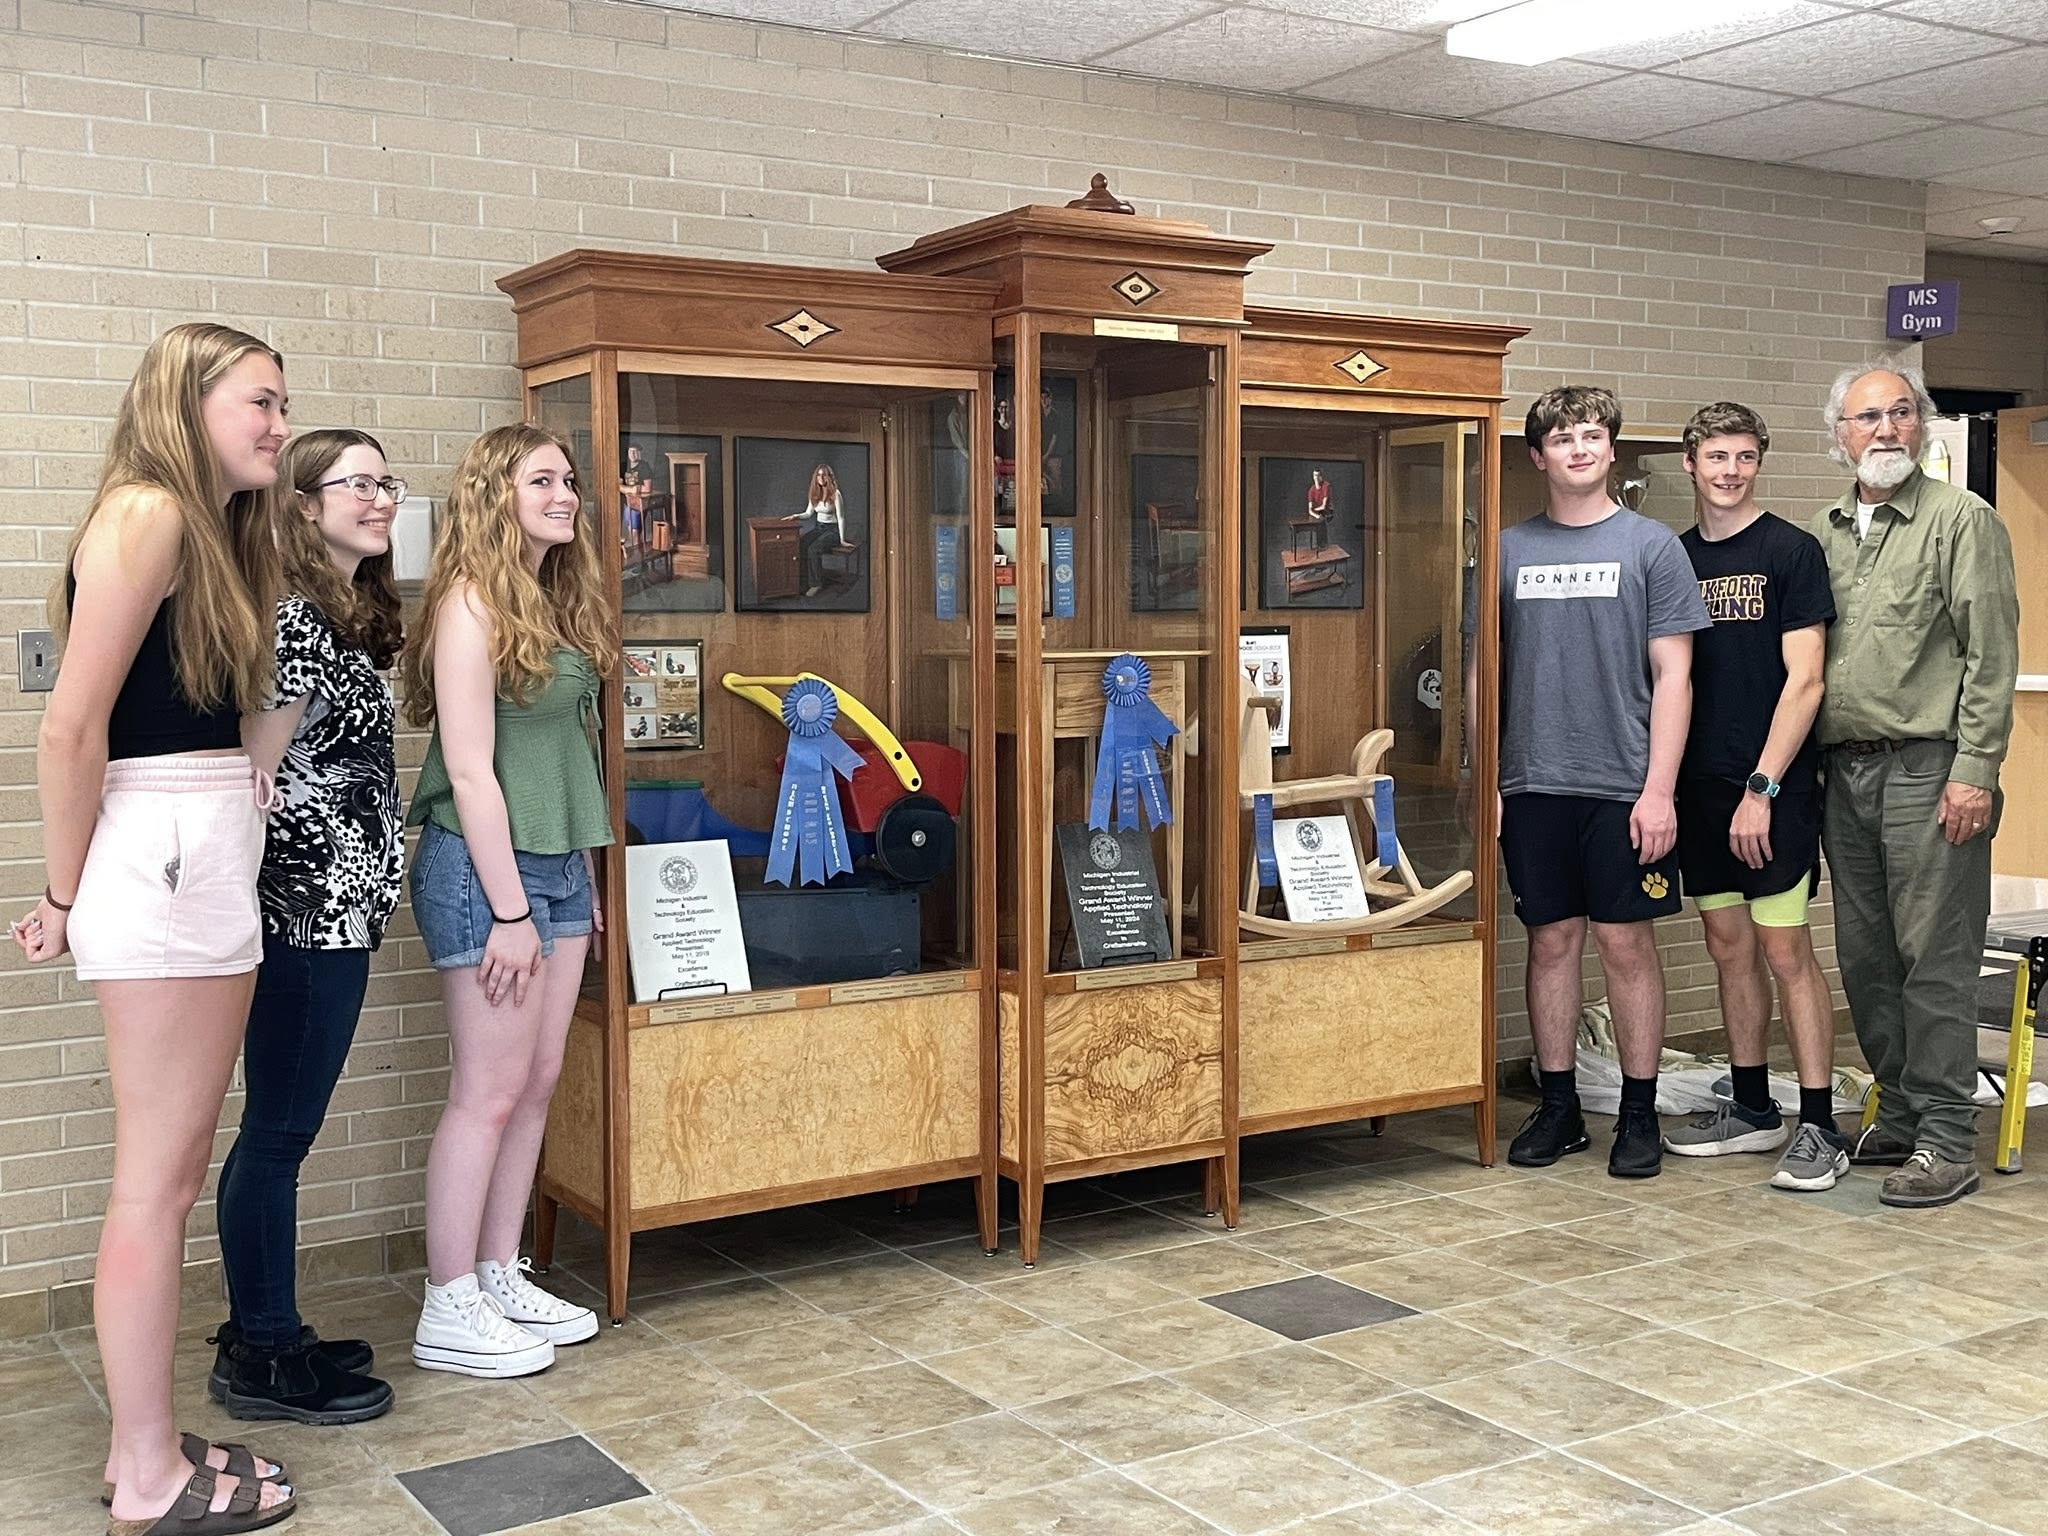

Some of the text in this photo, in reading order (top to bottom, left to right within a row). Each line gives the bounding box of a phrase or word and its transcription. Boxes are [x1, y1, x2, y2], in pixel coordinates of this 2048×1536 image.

[1908, 288, 1938, 306] MS
[1902, 313, 1942, 332] Gym
[1522, 571, 1616, 585] SONNETI
[1078, 897, 1102, 905] Grand
[1103, 896, 1127, 904] Award
[1111, 902, 1153, 910] Technology
[653, 928, 721, 940] Grand Award Winner
[1103, 941, 1147, 949] Craftsmanship
